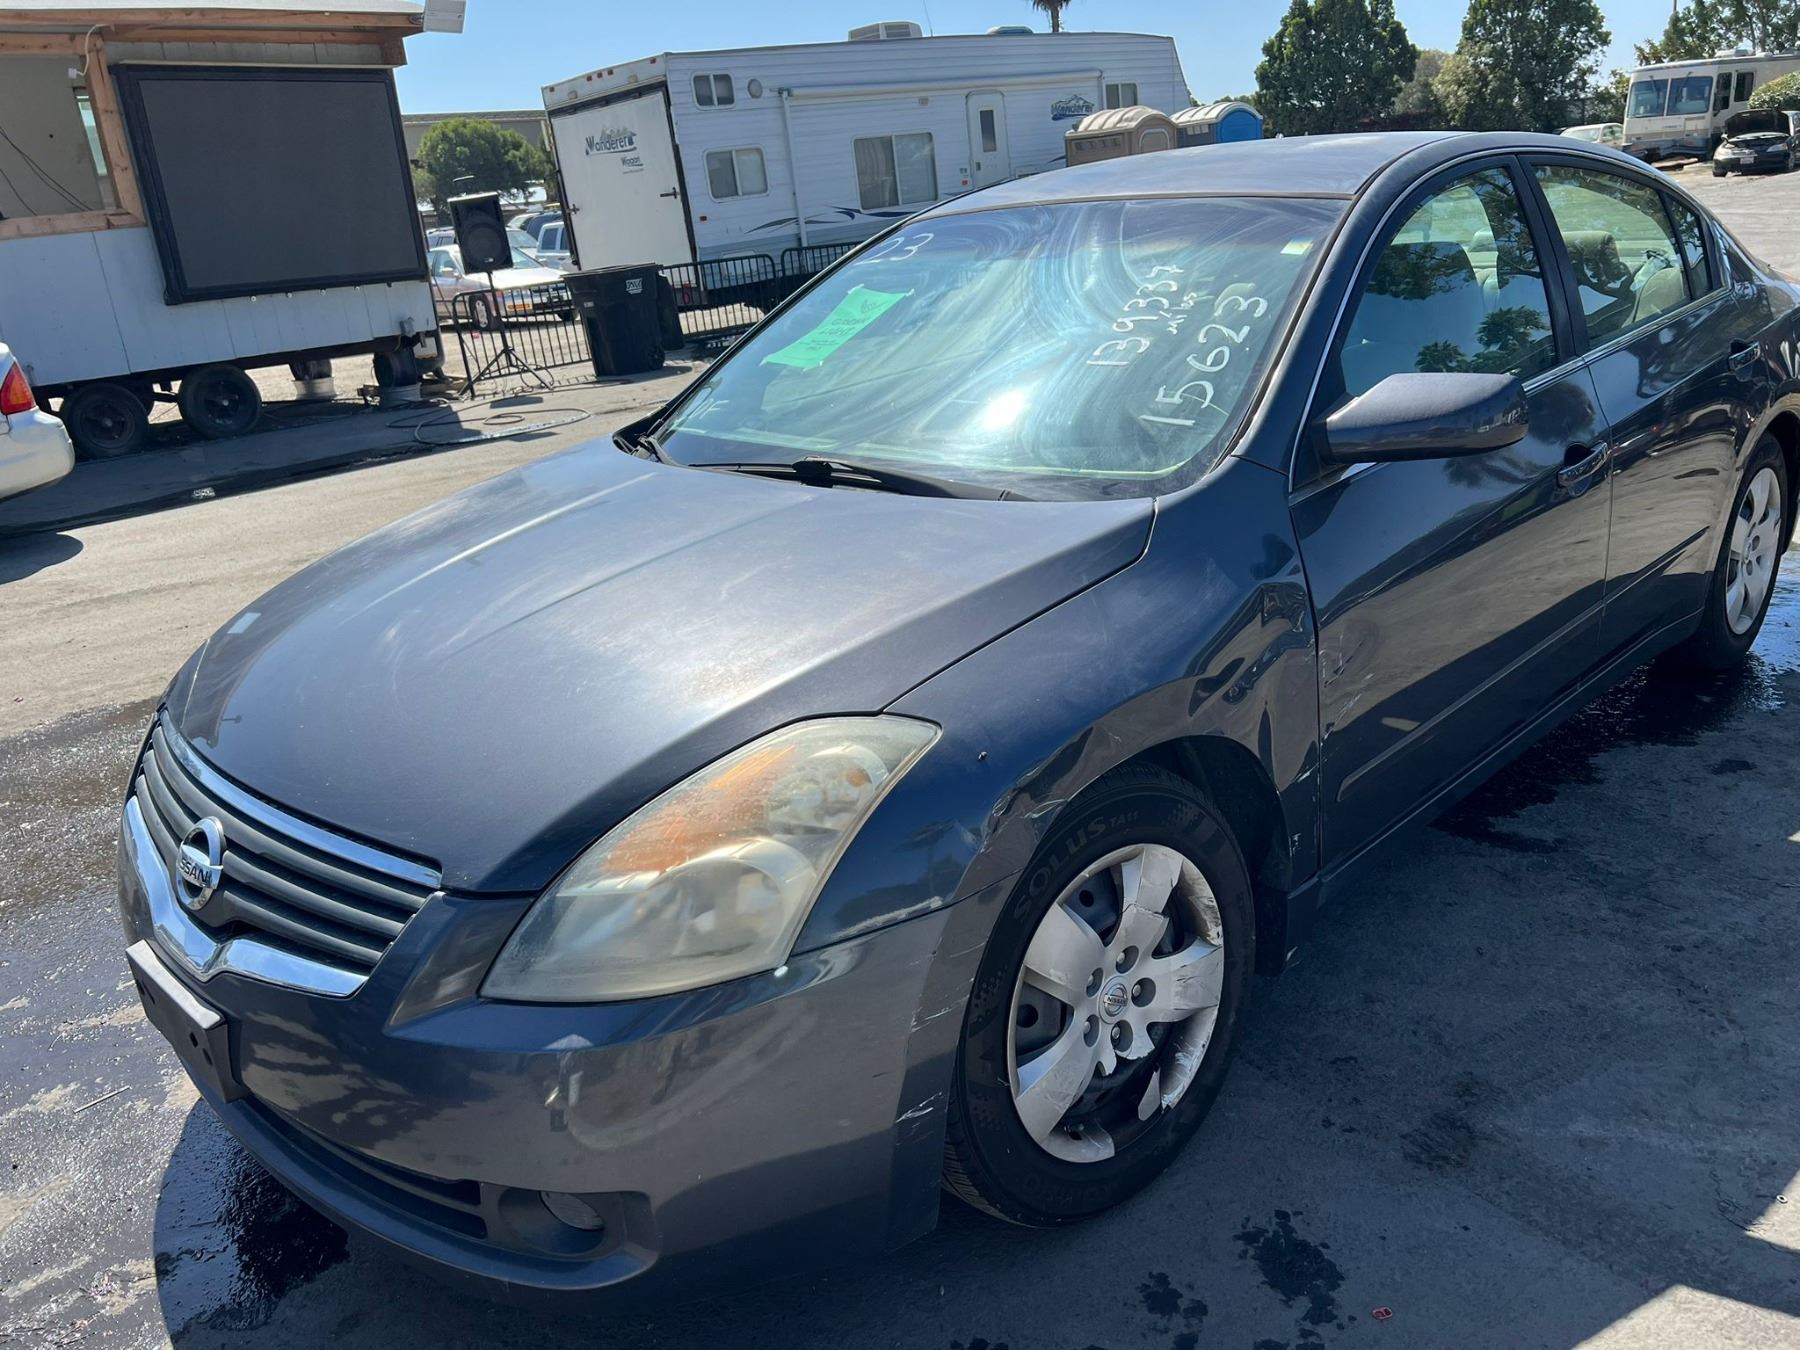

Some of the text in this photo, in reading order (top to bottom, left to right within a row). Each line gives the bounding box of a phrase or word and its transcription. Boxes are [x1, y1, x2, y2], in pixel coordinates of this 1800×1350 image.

[585, 134, 629, 152] Wanderer
[853, 232, 935, 266] 23
[1138, 295, 1268, 426] 15623
[1013, 815, 1106, 923] SOLUS
